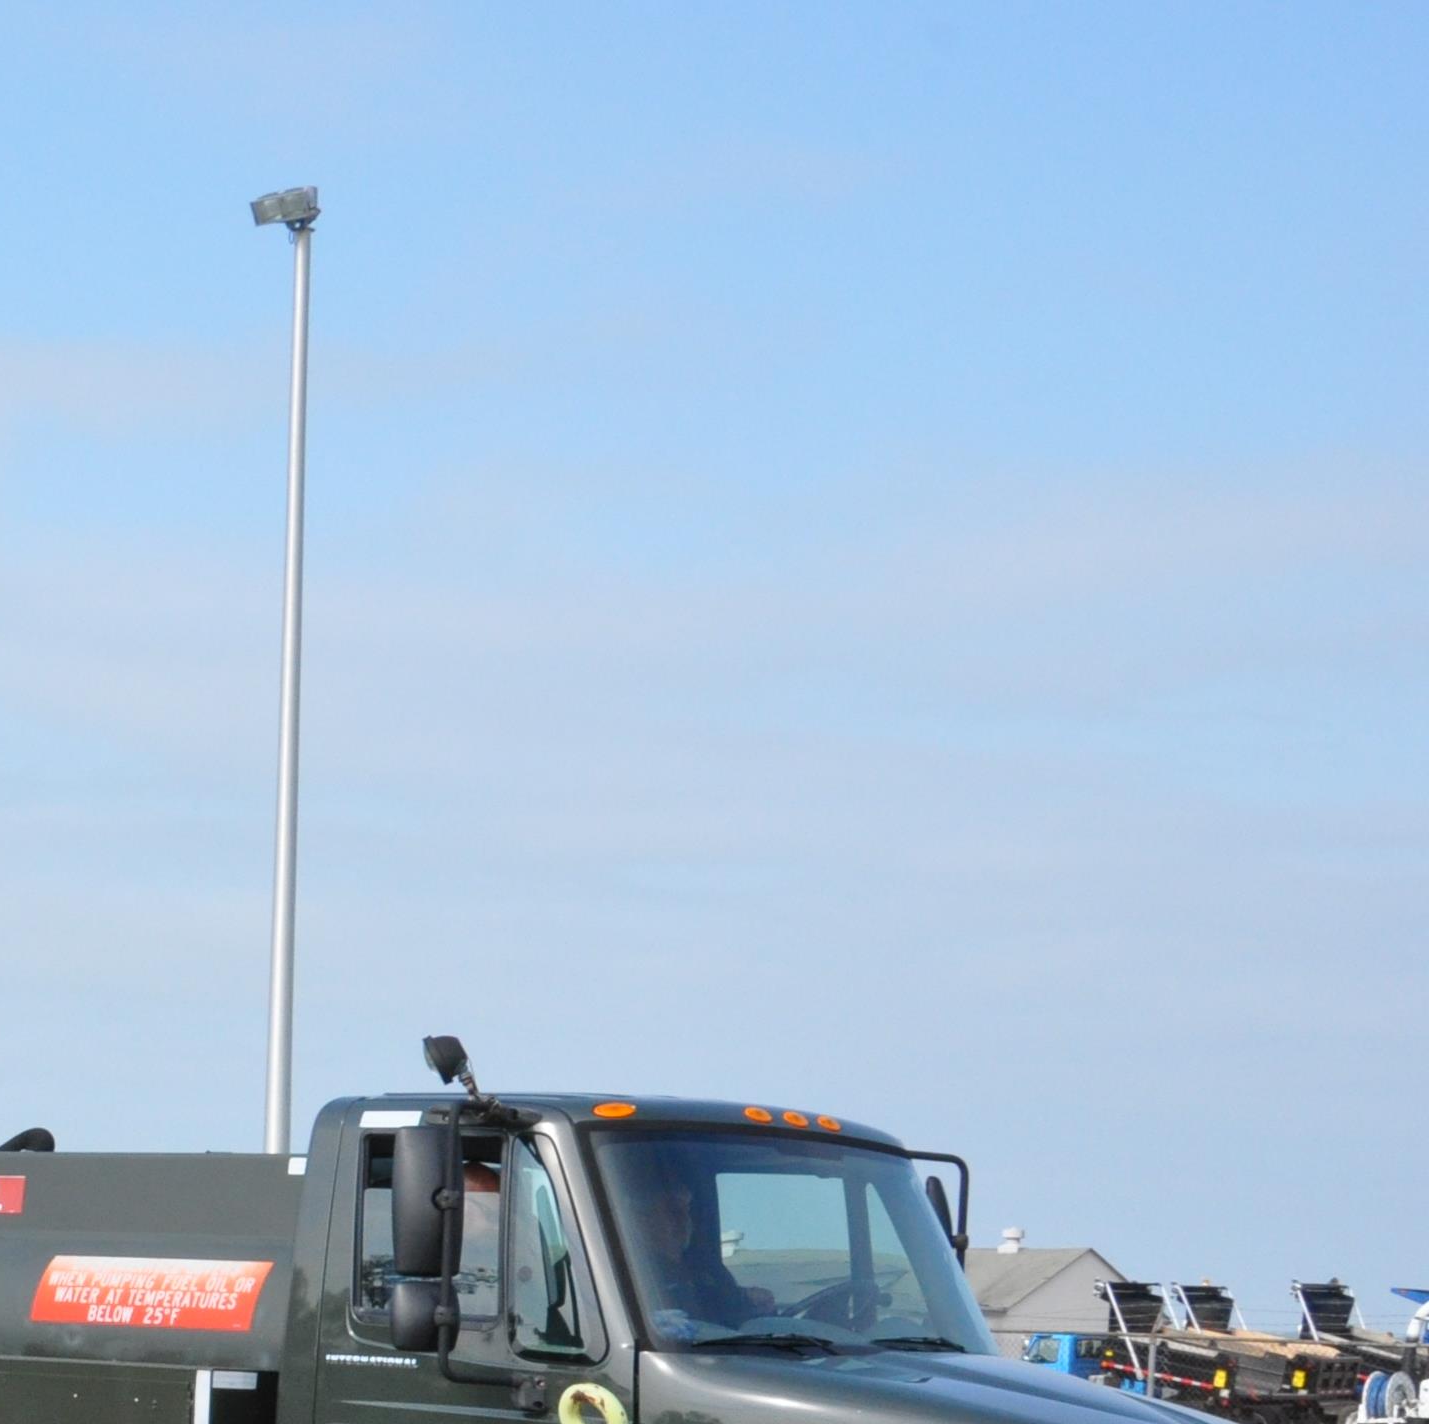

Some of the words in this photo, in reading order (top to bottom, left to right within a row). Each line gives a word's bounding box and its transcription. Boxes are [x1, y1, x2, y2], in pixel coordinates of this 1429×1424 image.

[48, 1270, 85, 1287] WHEN
[90, 1272, 156, 1290] PUMPING
[161, 1273, 199, 1291] FUEL
[205, 1275, 228, 1292] OIL
[234, 1276, 257, 1293] OR
[54, 1286, 99, 1305] WATER
[105, 1288, 124, 1305] AT
[129, 1289, 239, 1311] TEMPERATURES
[86, 1305, 134, 1324] BELOW
[142, 1308, 181, 1326] 25°F
[325, 1353, 418, 1367] INTERNATIONAL
